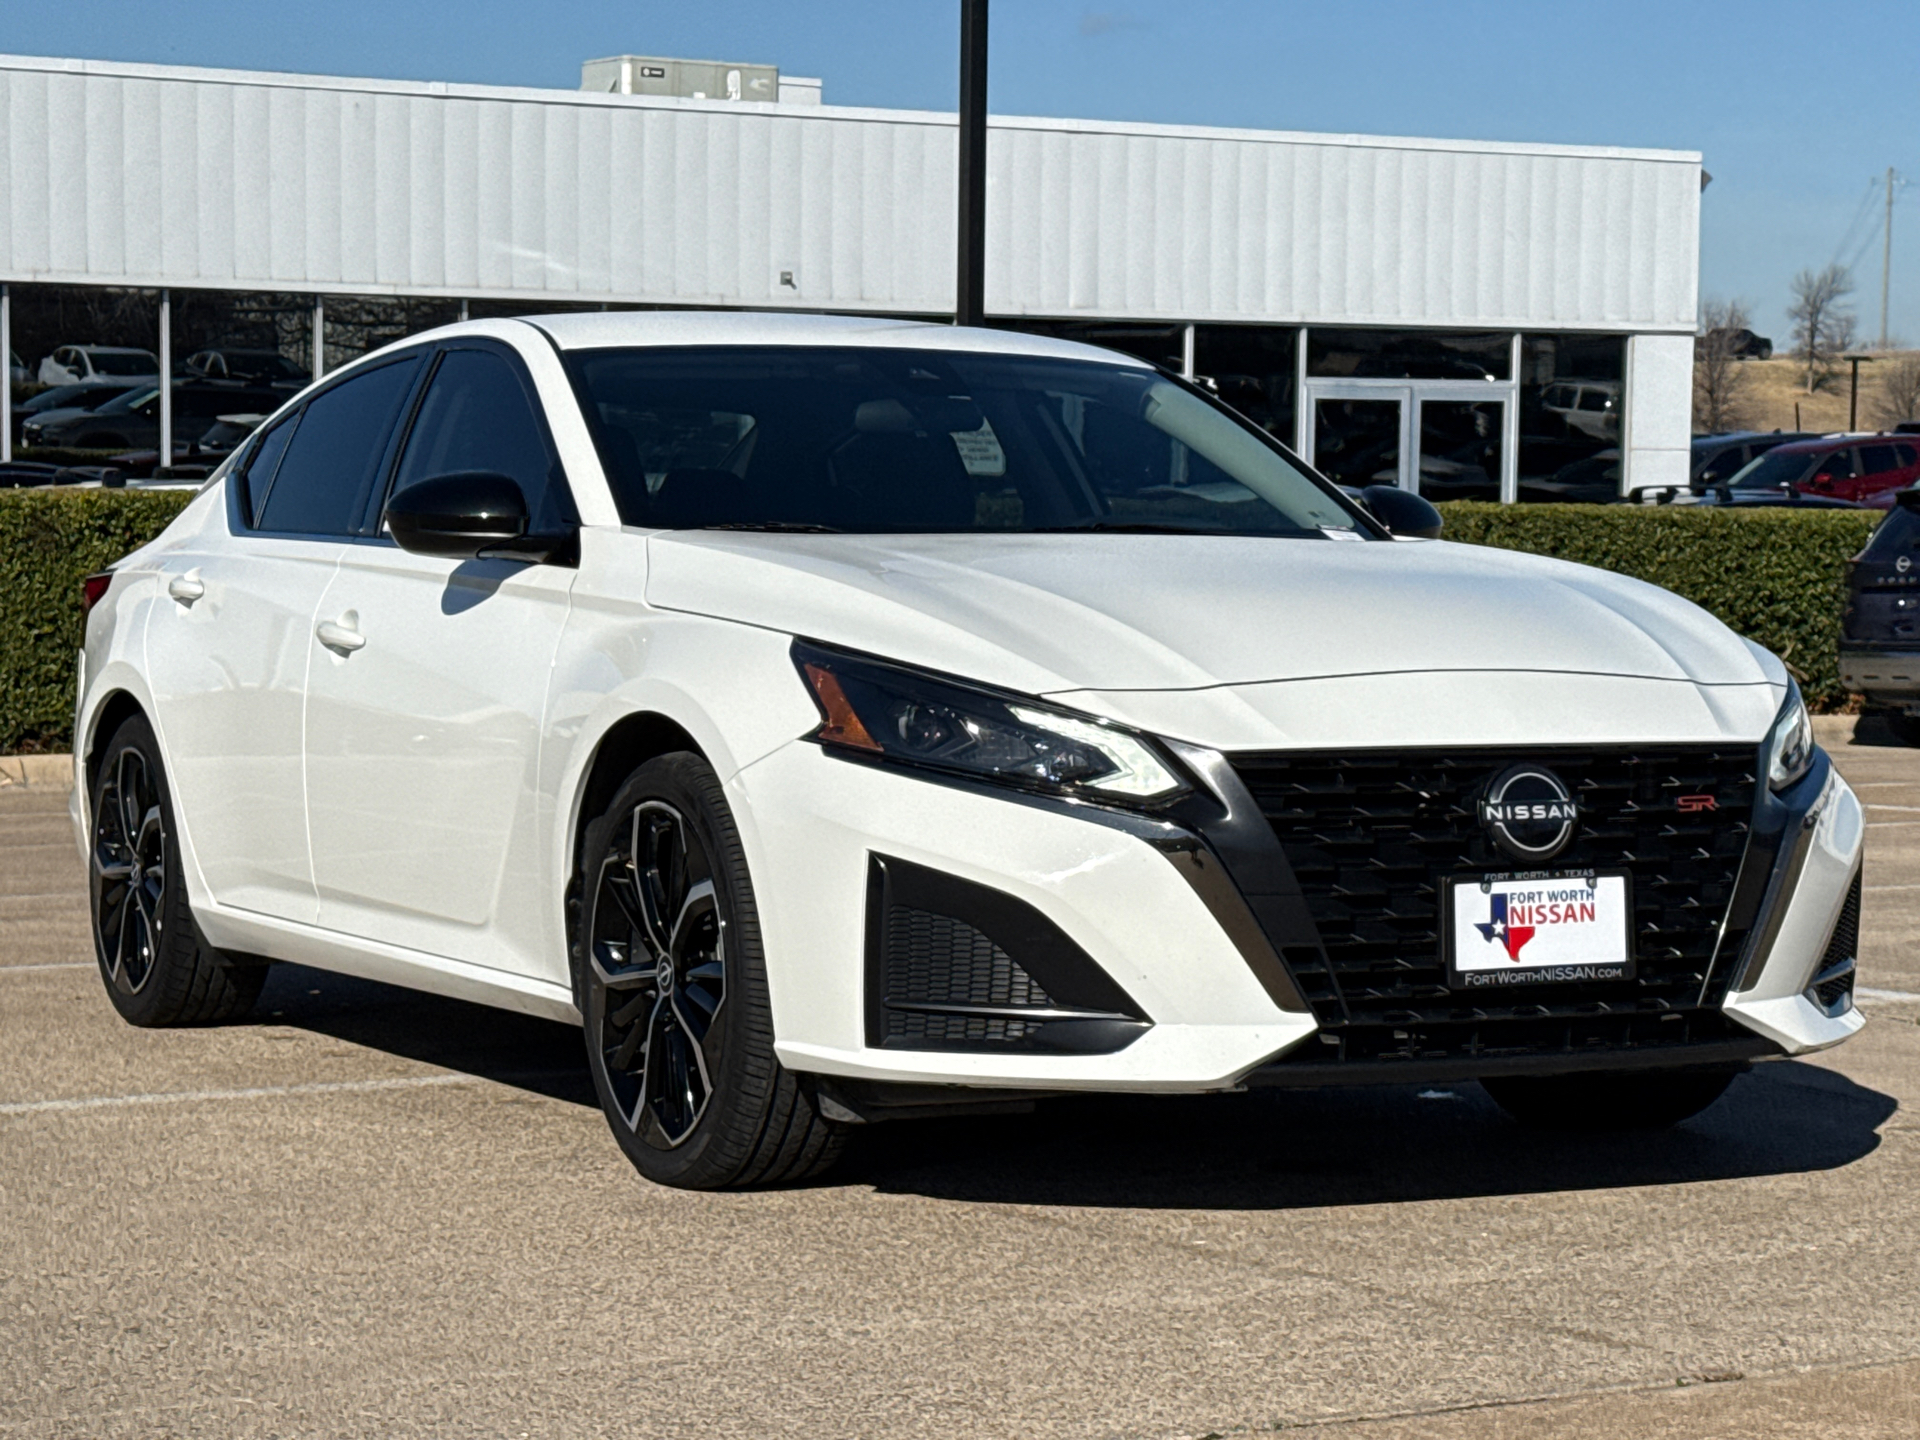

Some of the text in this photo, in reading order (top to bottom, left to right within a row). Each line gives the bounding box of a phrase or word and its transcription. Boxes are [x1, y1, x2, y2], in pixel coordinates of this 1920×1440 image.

[1677, 795, 1715, 812] SR
[1486, 804, 1576, 820] NISSAN
[1484, 868, 1595, 881] FORT WORTH TEXAS
[1509, 889, 1595, 904] FORT WORTH
[1510, 903, 1596, 925] NISSAN
